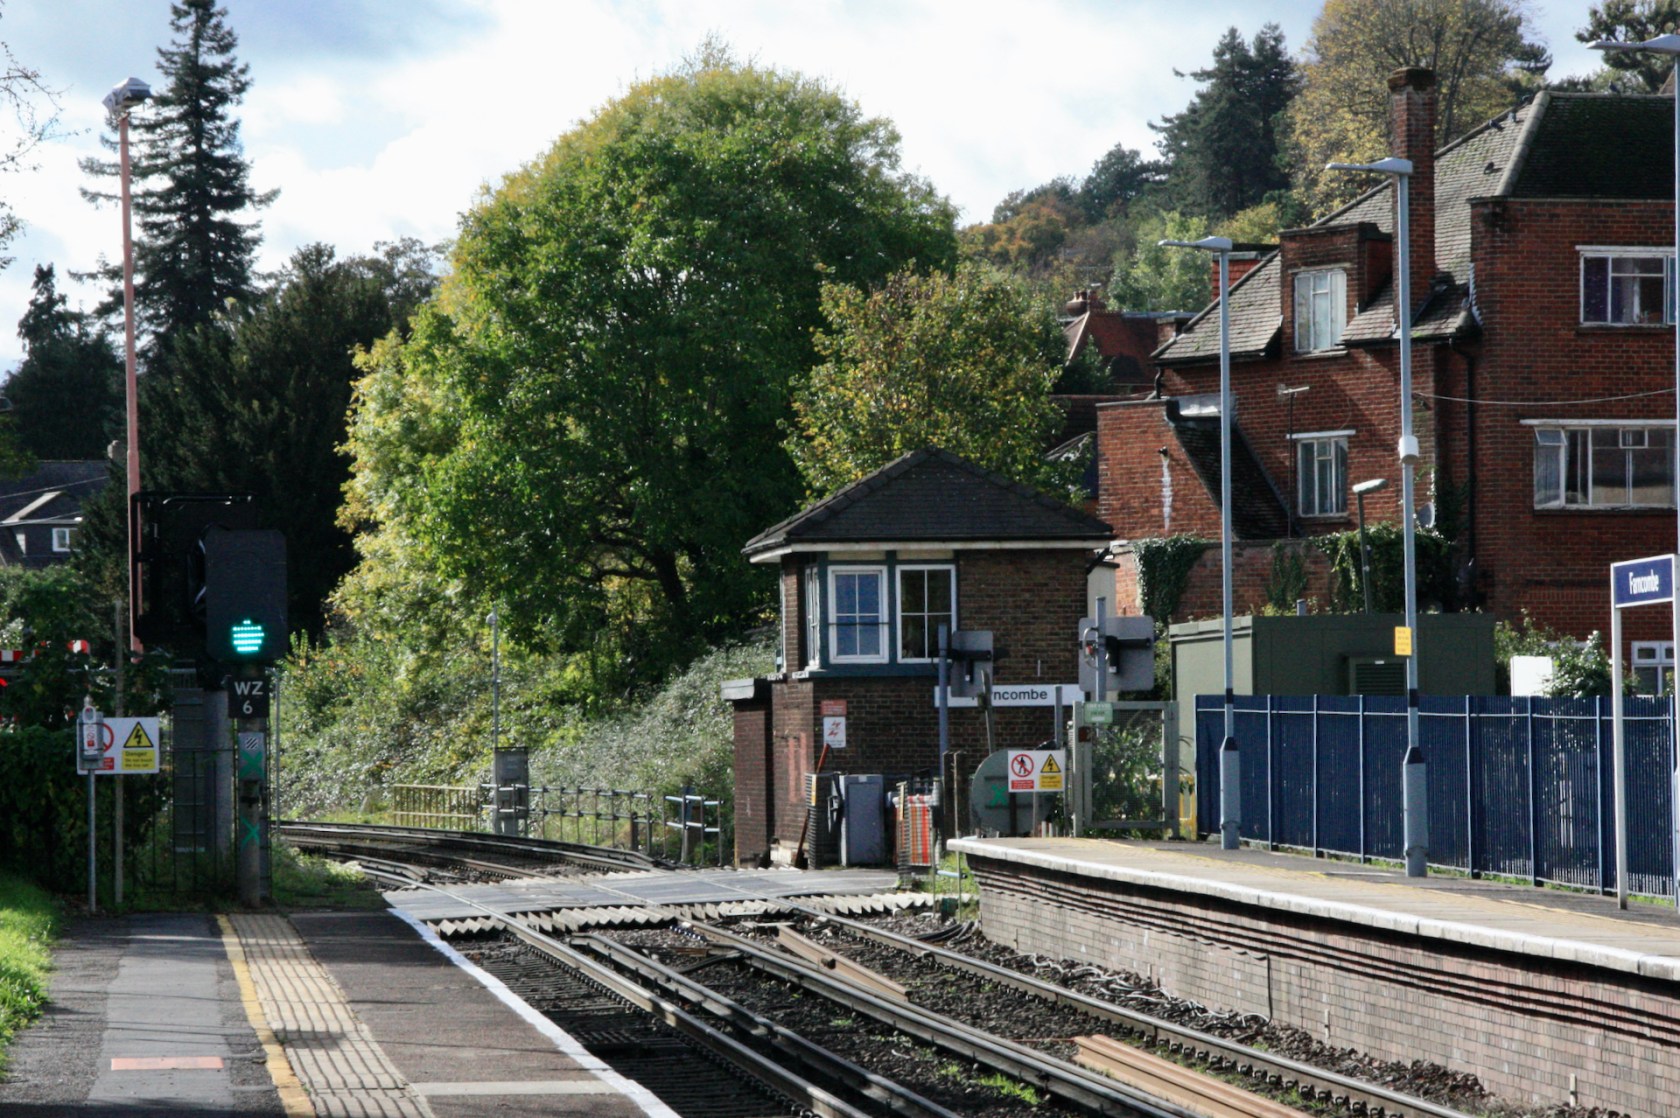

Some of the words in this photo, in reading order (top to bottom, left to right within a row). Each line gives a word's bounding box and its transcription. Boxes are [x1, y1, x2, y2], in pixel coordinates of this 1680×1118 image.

[1629, 569, 1659, 594] Farncombe
[234, 681, 263, 695] WZ
[972, 689, 1048, 700] ncombe
[243, 700, 253, 714] 6
